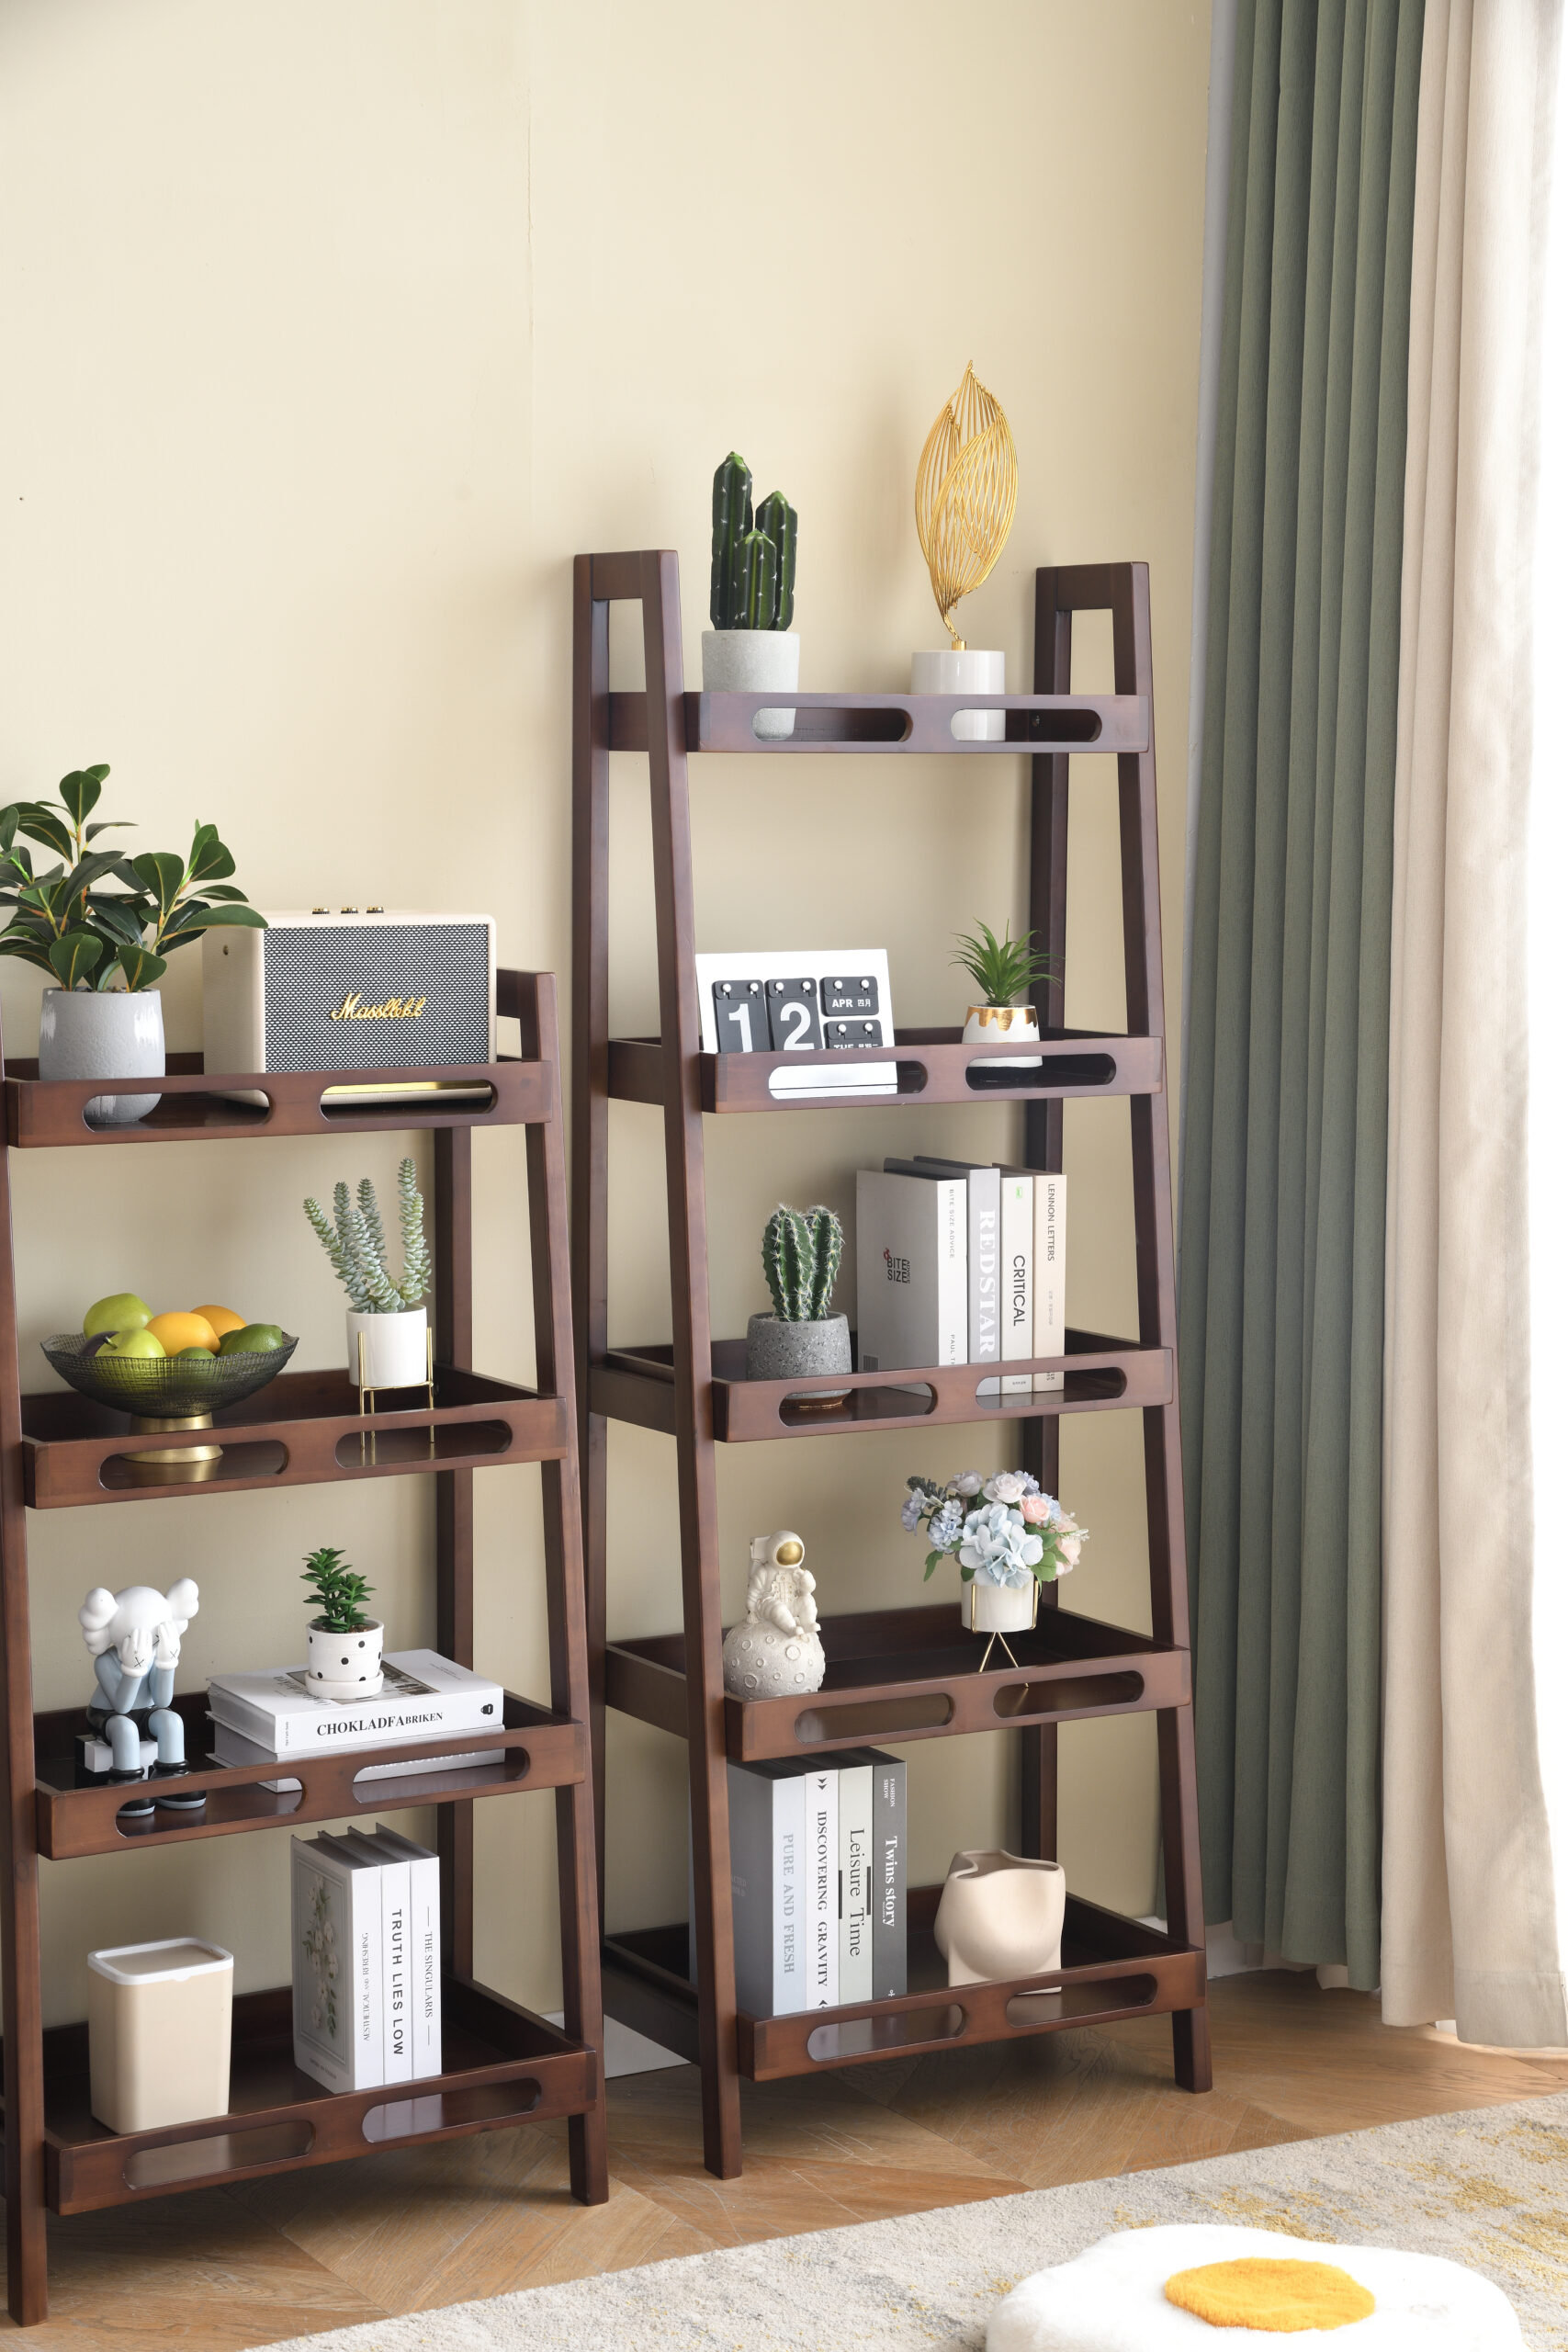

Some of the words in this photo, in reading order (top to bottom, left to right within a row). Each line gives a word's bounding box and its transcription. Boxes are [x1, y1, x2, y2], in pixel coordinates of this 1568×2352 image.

[780, 1001, 815, 1051] 2
[831, 998, 854, 1008] APR
[1047, 1183, 1056, 1223] LENNON
[979, 1209, 996, 1274] RED
[1047, 1225, 1055, 1261] LETTERS
[886, 1268, 908, 1284] SIZE
[1012, 1255, 1026, 1328] CRITICAL
[978, 1276, 996, 1355] STAR
[316, 1712, 444, 1736] CHOKLADFABRIKEN
[783, 1833, 795, 1877] PURE
[850, 1828, 865, 1897] Leisure
[885, 1835, 898, 1884] Twins
[784, 1883, 795, 1917] AND
[882, 1887, 896, 1928] story
[391, 1908, 403, 1966] TRUTH
[424, 1930, 434, 1953] THE
[784, 1924, 796, 1974] FRESH
[818, 1921, 829, 1986] GRAVITY
[850, 1906, 865, 1957] Time
[392, 1973, 404, 2011] LIES
[424, 1955, 434, 2018] SINGULARIS
[392, 2018, 404, 2056] LOW
